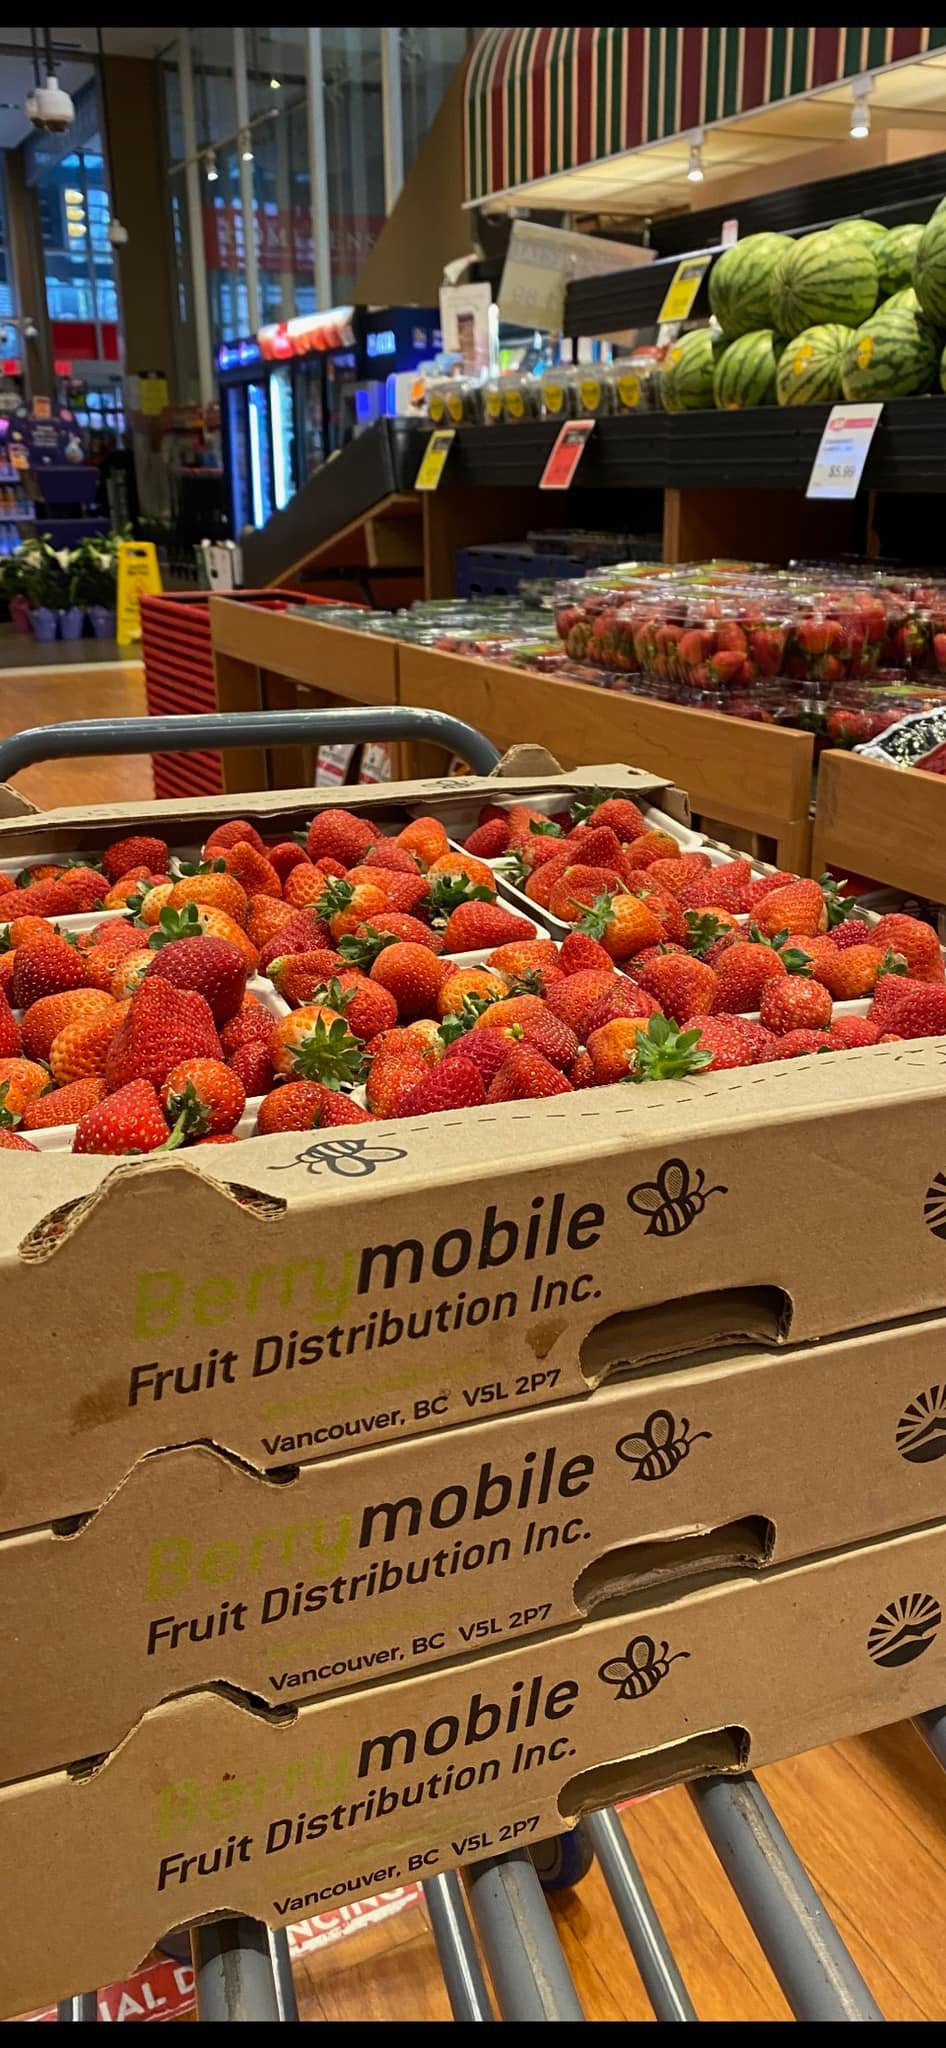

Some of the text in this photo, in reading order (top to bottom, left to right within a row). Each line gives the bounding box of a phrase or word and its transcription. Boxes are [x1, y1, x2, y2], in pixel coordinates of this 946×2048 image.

[134, 1193, 605, 1341] Berrymobile
[127, 1349, 237, 1407] Fruit
[253, 1289, 517, 1377] Distribution
[530, 1274, 602, 1314] Inc.
[261, 1409, 405, 1456] Vancouver,
[414, 1396, 449, 1420] BC
[462, 1381, 509, 1407] V5L
[515, 1368, 561, 1396] 2P7
[146, 1446, 594, 1602] Berrymobile
[146, 1603, 248, 1655] Fruit
[260, 1535, 510, 1625] Distribution
[523, 1518, 591, 1556] Inc.
[268, 1646, 404, 1692] Vancouver,
[412, 1632, 446, 1656] BC
[458, 1617, 503, 1643] V5L
[508, 1604, 553, 1632] 2P7
[156, 1838, 253, 1892] Fruit
[265, 1752, 500, 1856] Distribution
[511, 1735, 576, 1774] Inc.
[273, 1815, 541, 1917] Vancouver, BC V5L 2P7
